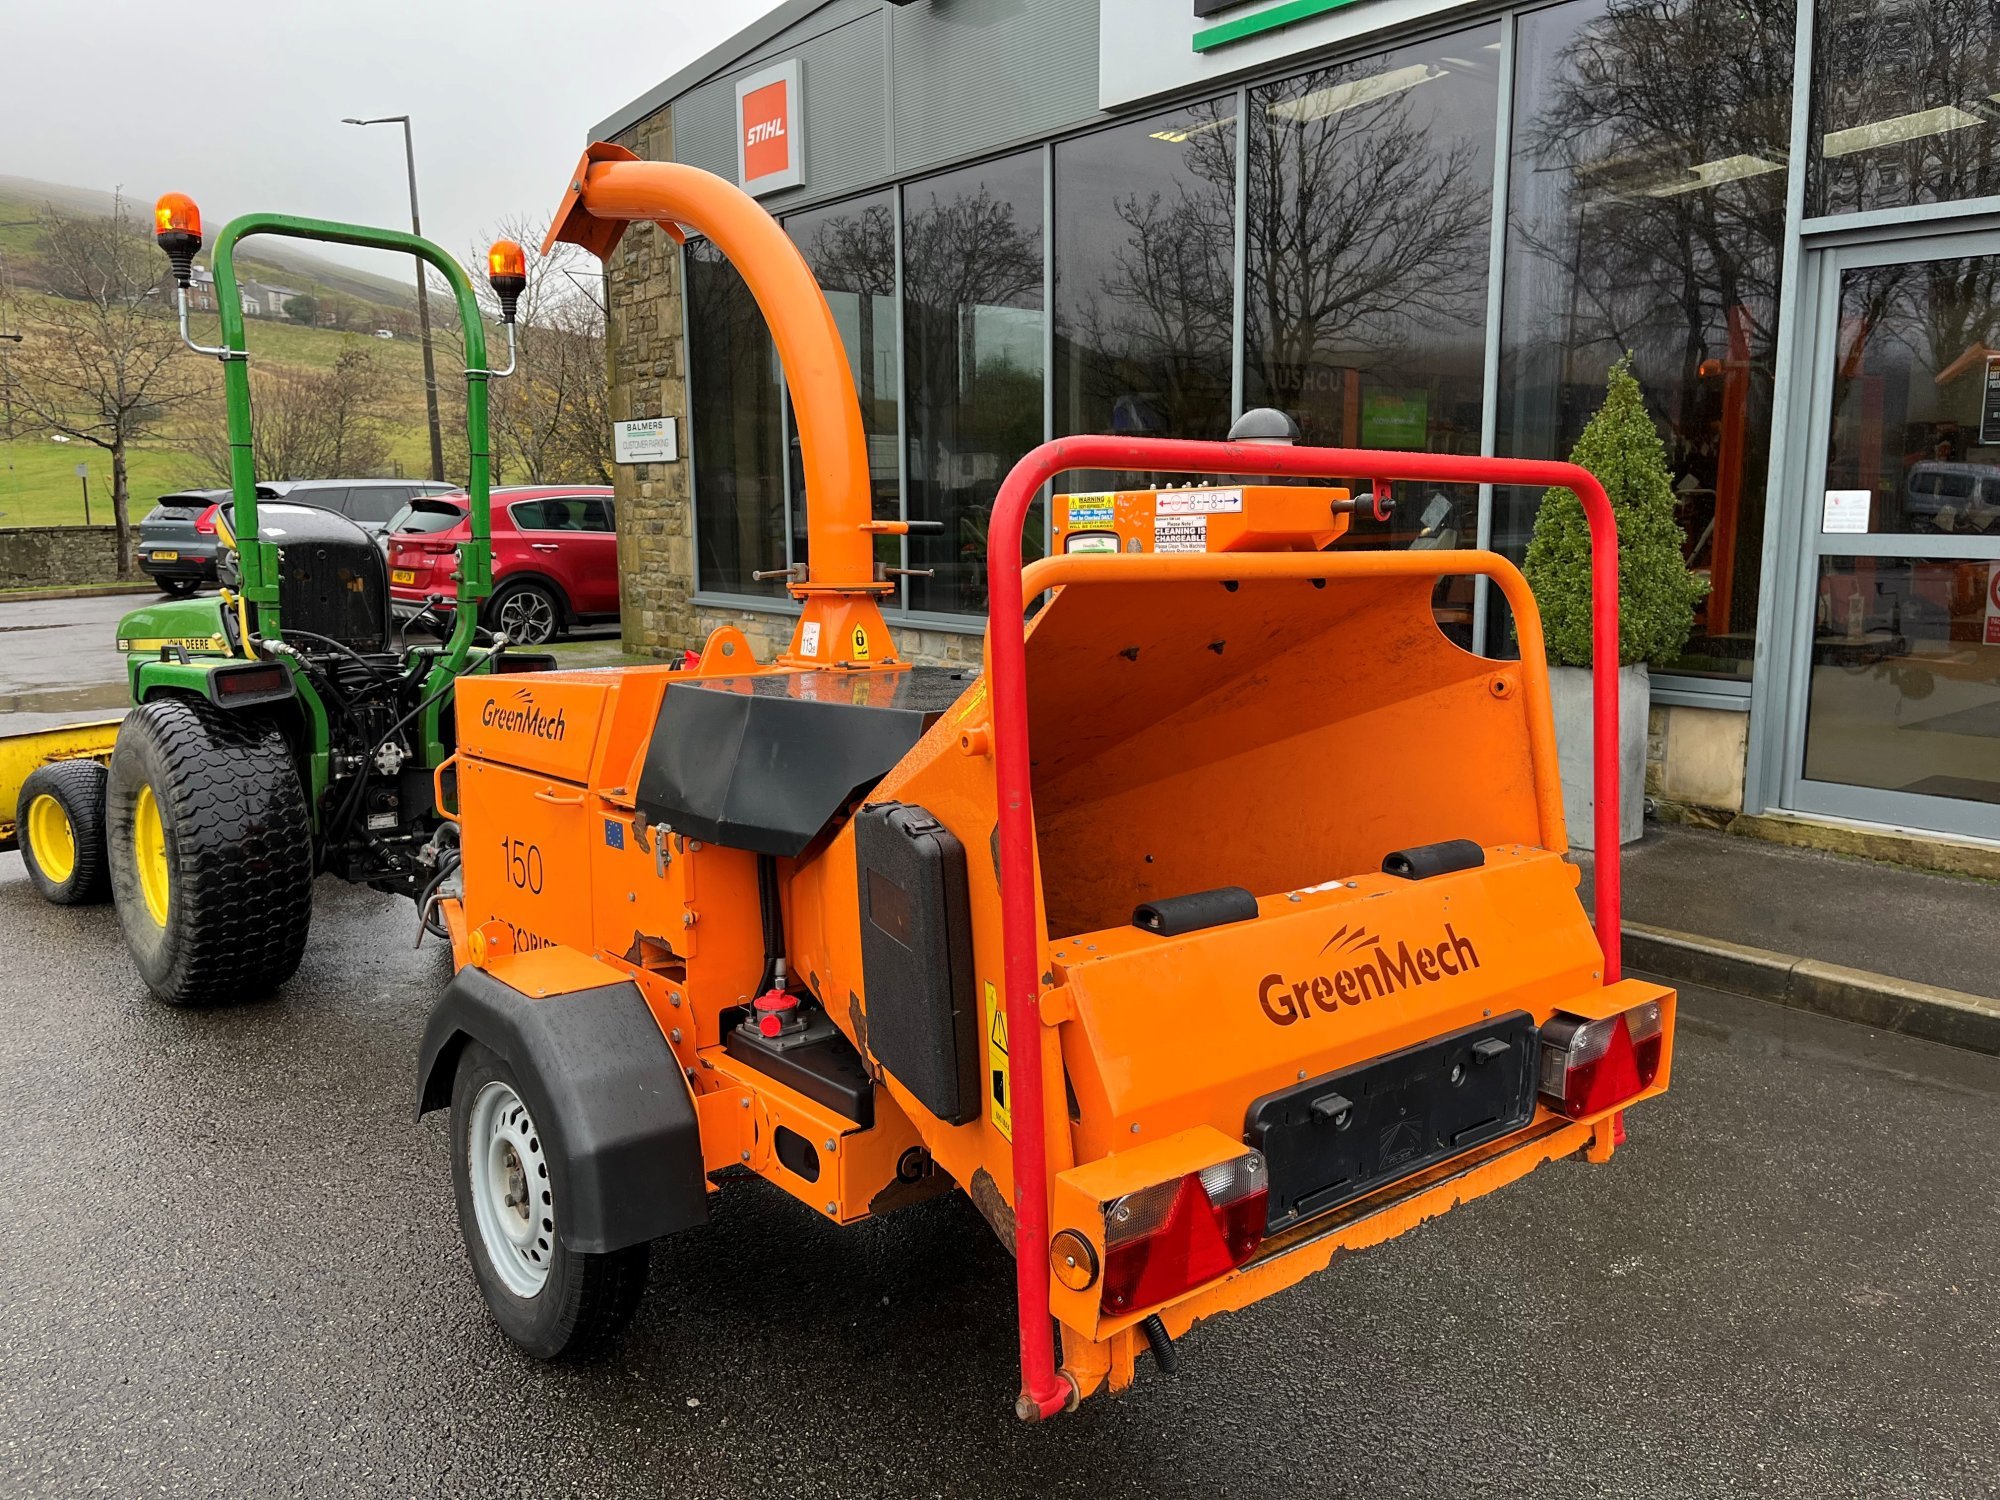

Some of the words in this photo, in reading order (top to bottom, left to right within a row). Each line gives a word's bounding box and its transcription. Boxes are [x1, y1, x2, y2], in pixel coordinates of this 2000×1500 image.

[746, 117, 785, 147] STIHL
[626, 421, 663, 432] BALMERS
[622, 440, 648, 450] CUSTOMER
[649, 438, 669, 448] PARKING
[1154, 527, 1196, 535] CLEANING
[1197, 526, 1206, 534] IS
[1154, 534, 1206, 542] CHARGEABLE
[185, 639, 209, 650] DEERE
[481, 698, 566, 742] GreenMech
[501, 835, 543, 895] 150
[1258, 922, 1481, 1027] GreenMech
